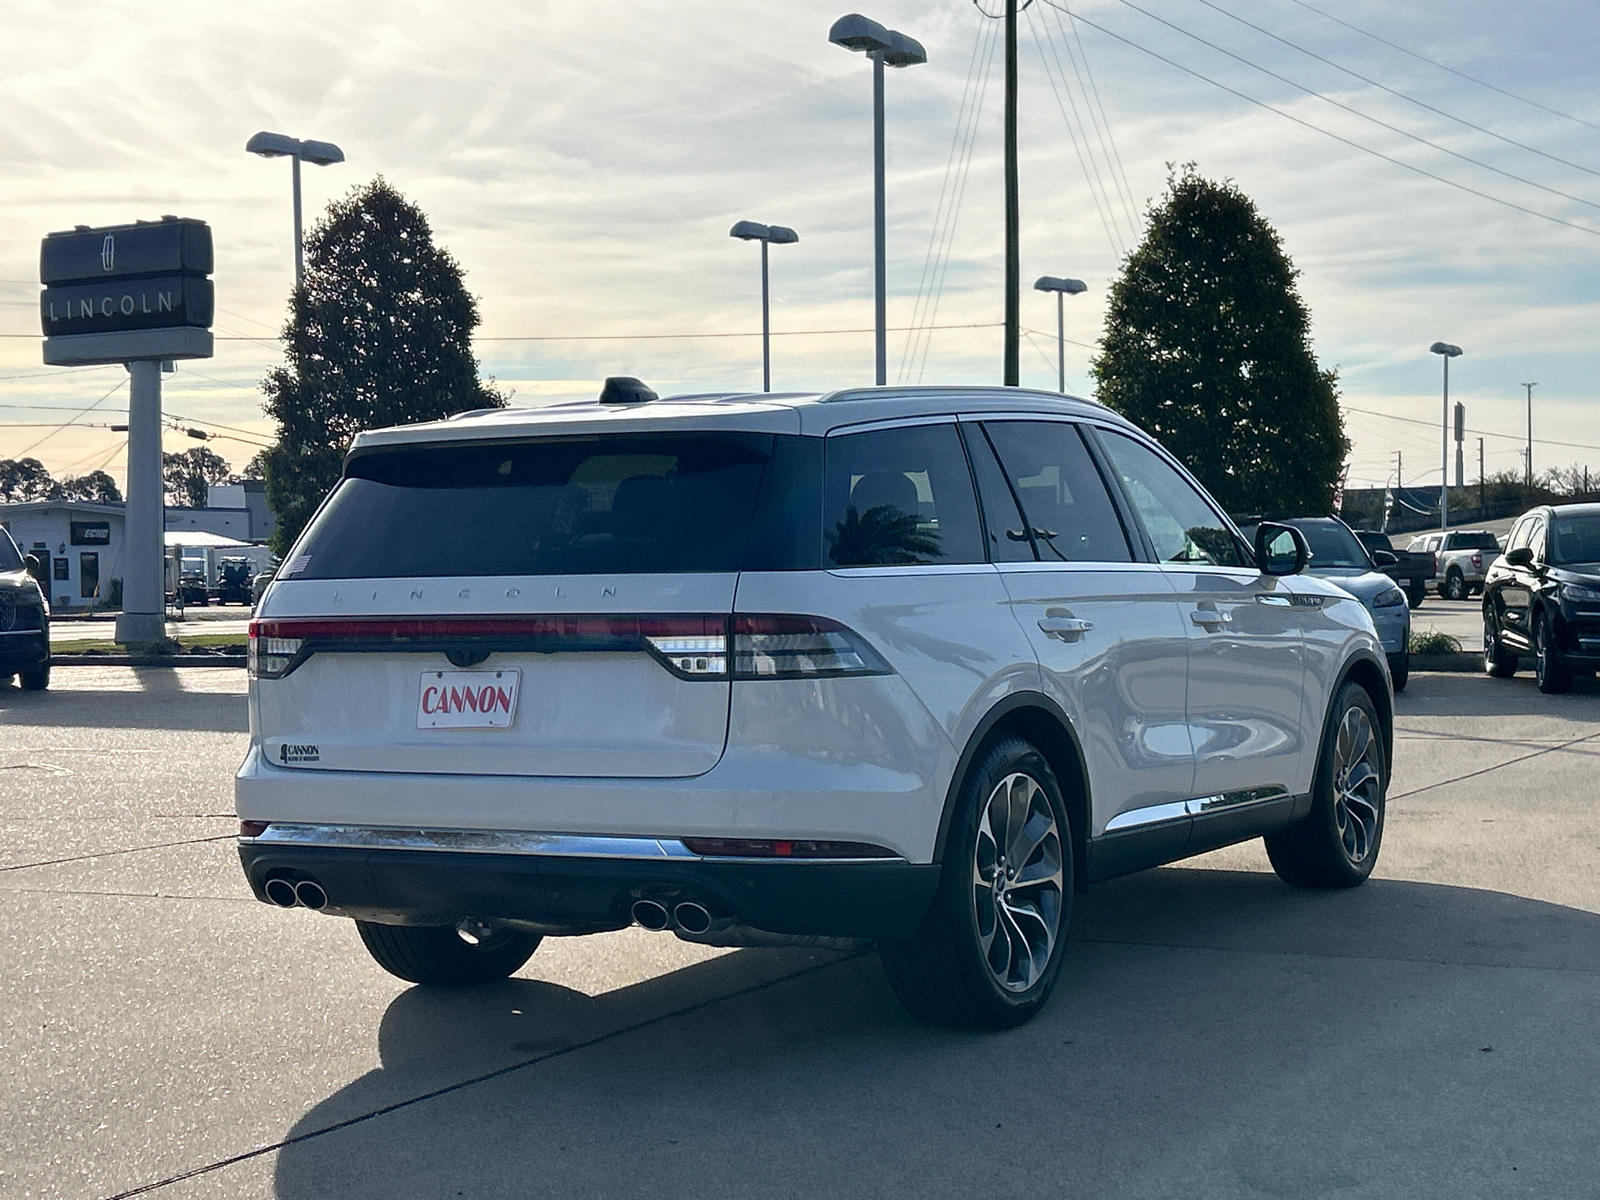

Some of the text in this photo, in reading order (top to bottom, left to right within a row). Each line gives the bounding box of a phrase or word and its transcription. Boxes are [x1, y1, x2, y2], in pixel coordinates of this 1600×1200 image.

[50, 291, 172, 321] LINCOLN
[333, 586, 617, 602] LINCOLN
[422, 685, 513, 714] CANNON
[288, 744, 319, 755] CANNON
